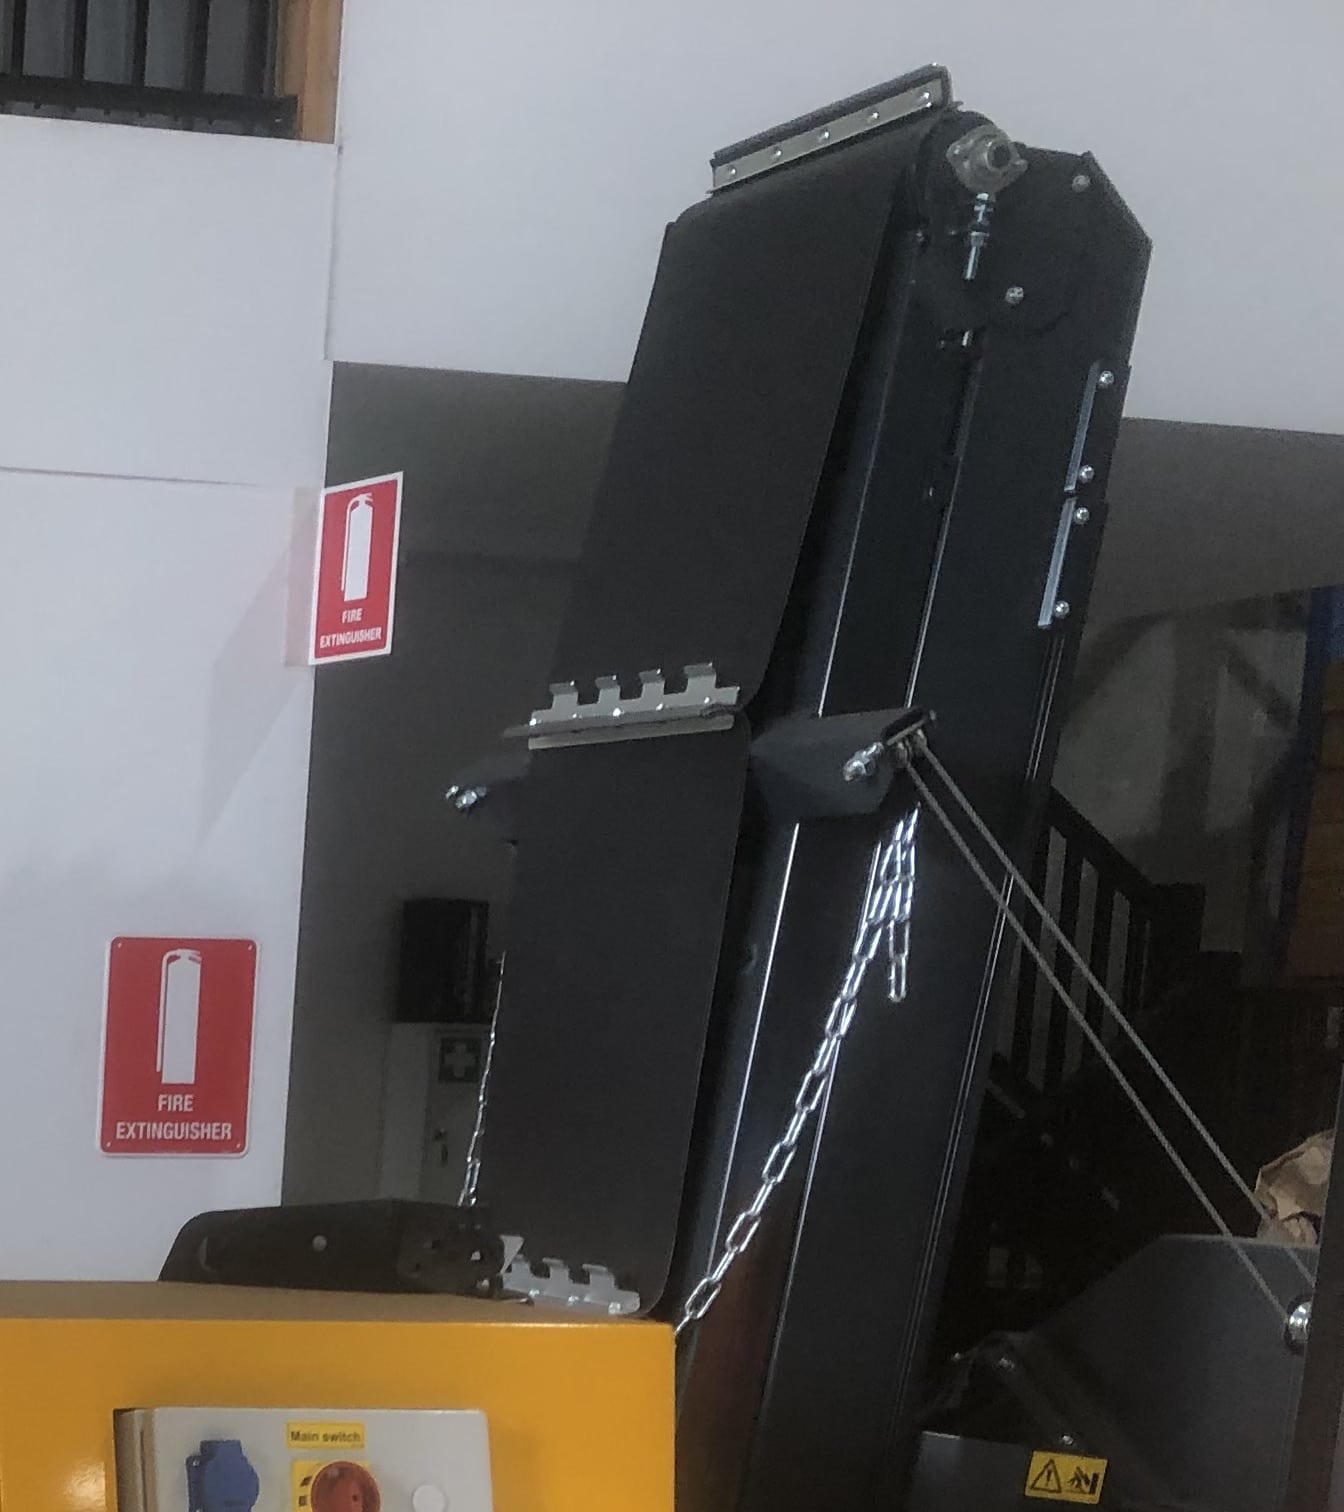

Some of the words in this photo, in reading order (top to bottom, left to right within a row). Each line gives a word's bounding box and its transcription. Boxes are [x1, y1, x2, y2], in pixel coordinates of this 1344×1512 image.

[342, 608, 363, 623] FIRE
[320, 627, 382, 649] EXTINGUISHER
[158, 1094, 194, 1112] FIRE
[116, 1122, 232, 1140] EXTINGUISHER
[290, 1431, 319, 1442] Main
[323, 1432, 361, 1443] switch
